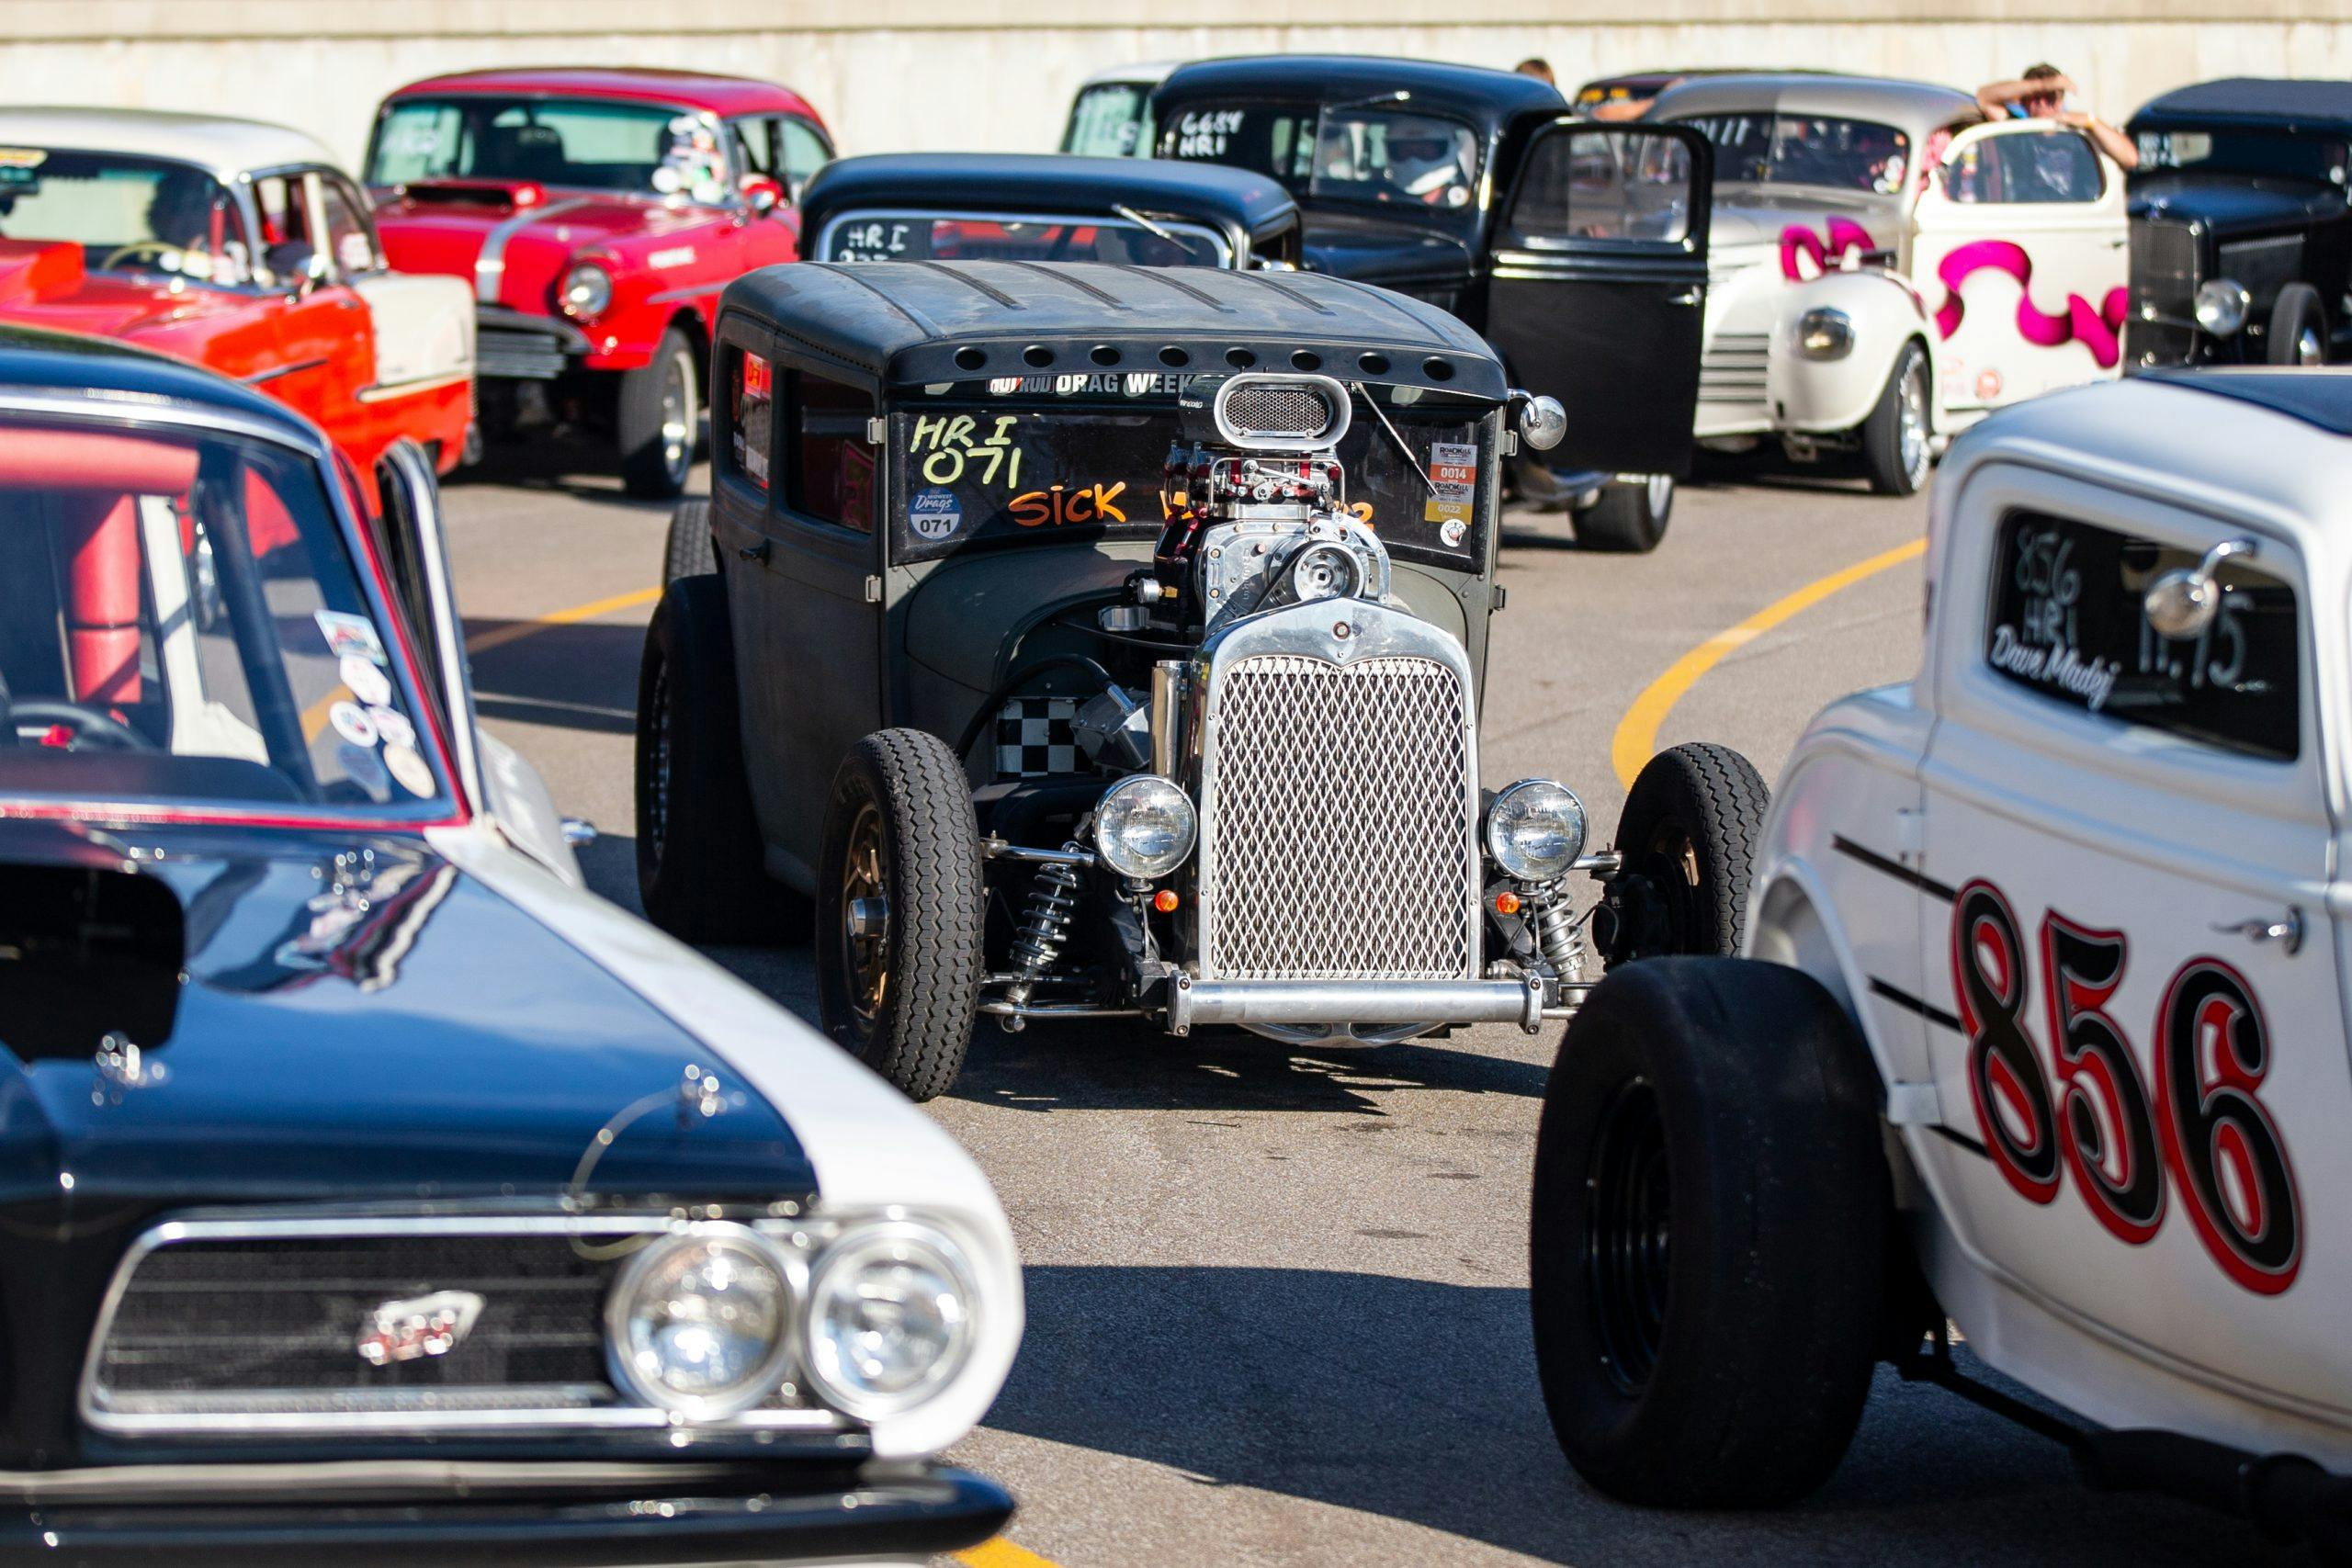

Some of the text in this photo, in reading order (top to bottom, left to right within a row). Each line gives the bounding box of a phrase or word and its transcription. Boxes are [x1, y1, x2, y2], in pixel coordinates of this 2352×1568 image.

[1057, 374, 1118, 393] DRAG
[910, 415, 977, 452] HR
[922, 446, 1022, 489] 071
[1441, 467, 1466, 479] 0014
[915, 494, 953, 513] Drags
[1438, 503, 1461, 513] 0022
[920, 519, 951, 533] 071
[2015, 525, 2082, 606] 856
[1991, 625, 2045, 680] Dave
[1950, 876, 2303, 1296] 856
